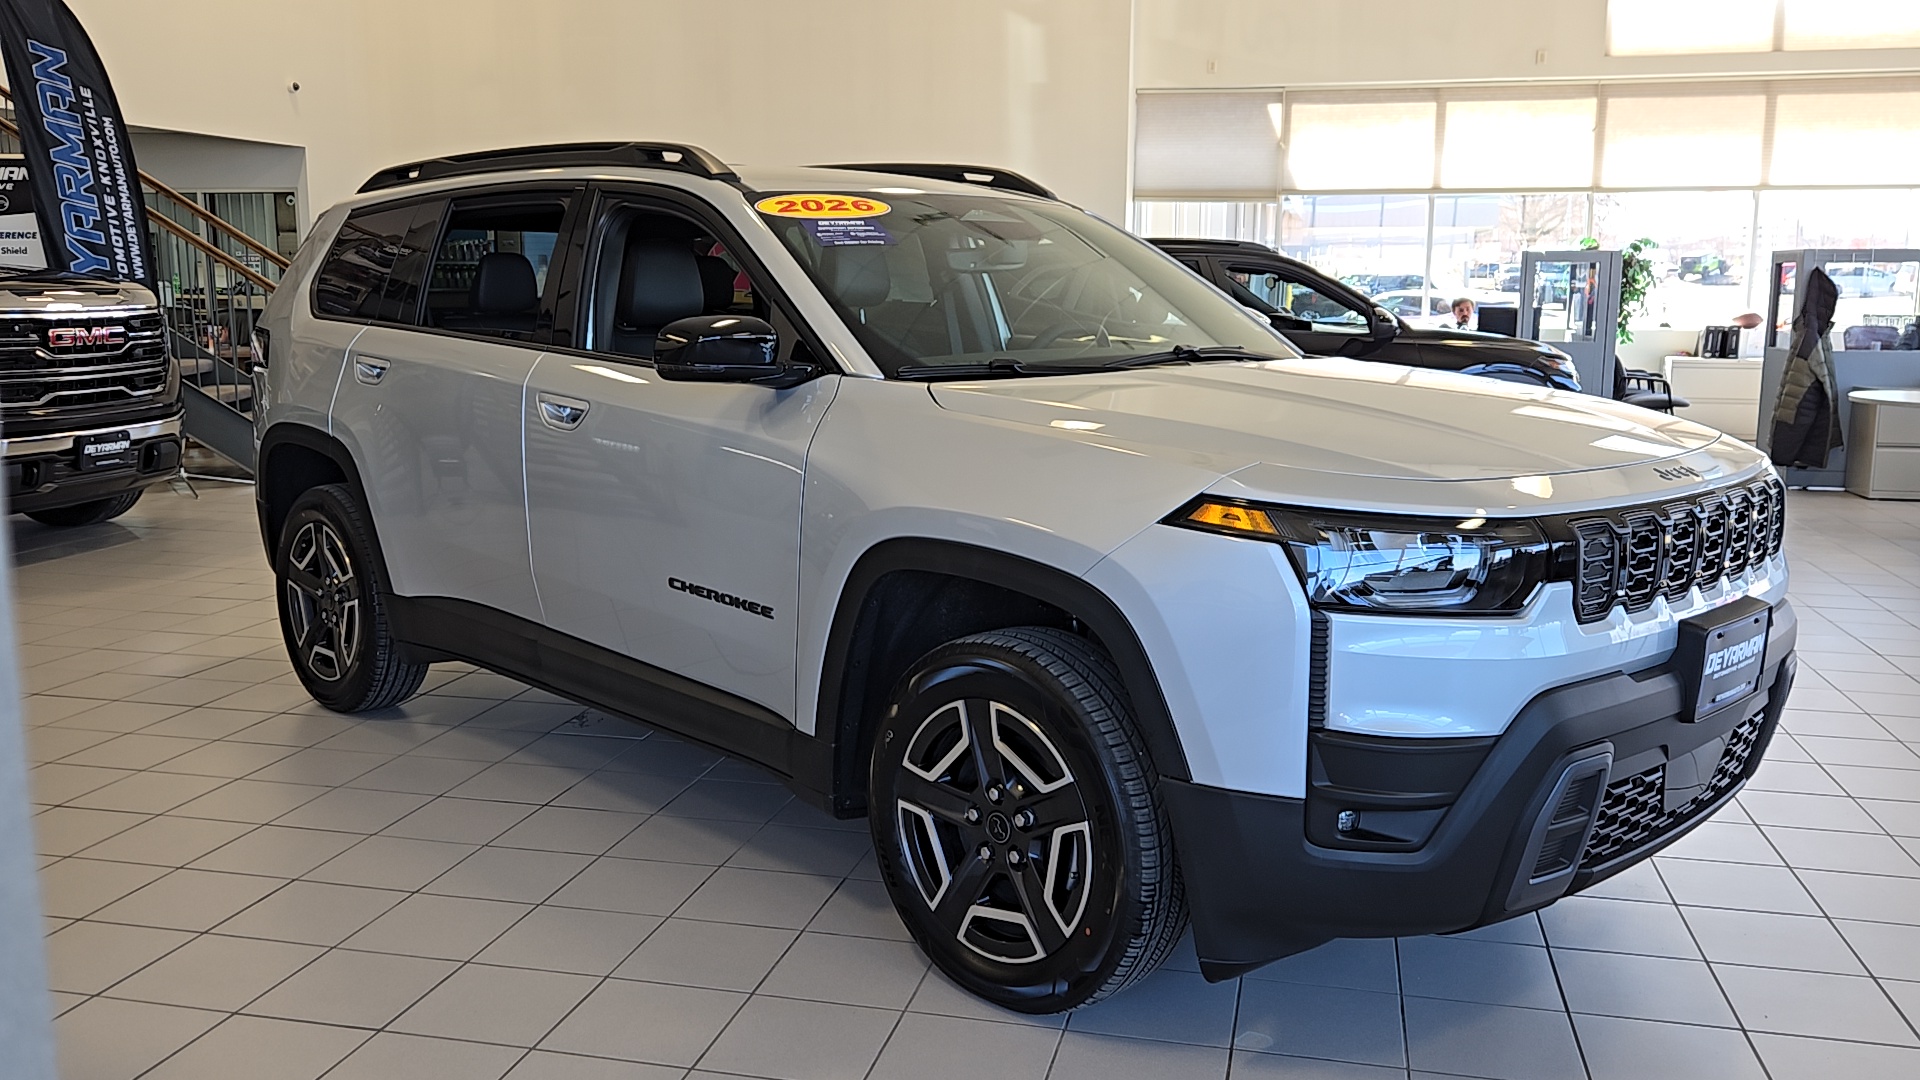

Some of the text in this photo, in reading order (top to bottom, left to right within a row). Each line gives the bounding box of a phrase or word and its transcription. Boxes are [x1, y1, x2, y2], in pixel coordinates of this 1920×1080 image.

[101, 116, 145, 280] WWW.DEYARMANAUTO.COM
[774, 200, 875, 213] 2026
[1, 247, 28, 255] Shield
[48, 326, 125, 347] GMC
[667, 576, 775, 620] CHEROKEE
[1703, 632, 1766, 676] DEYARMAN
